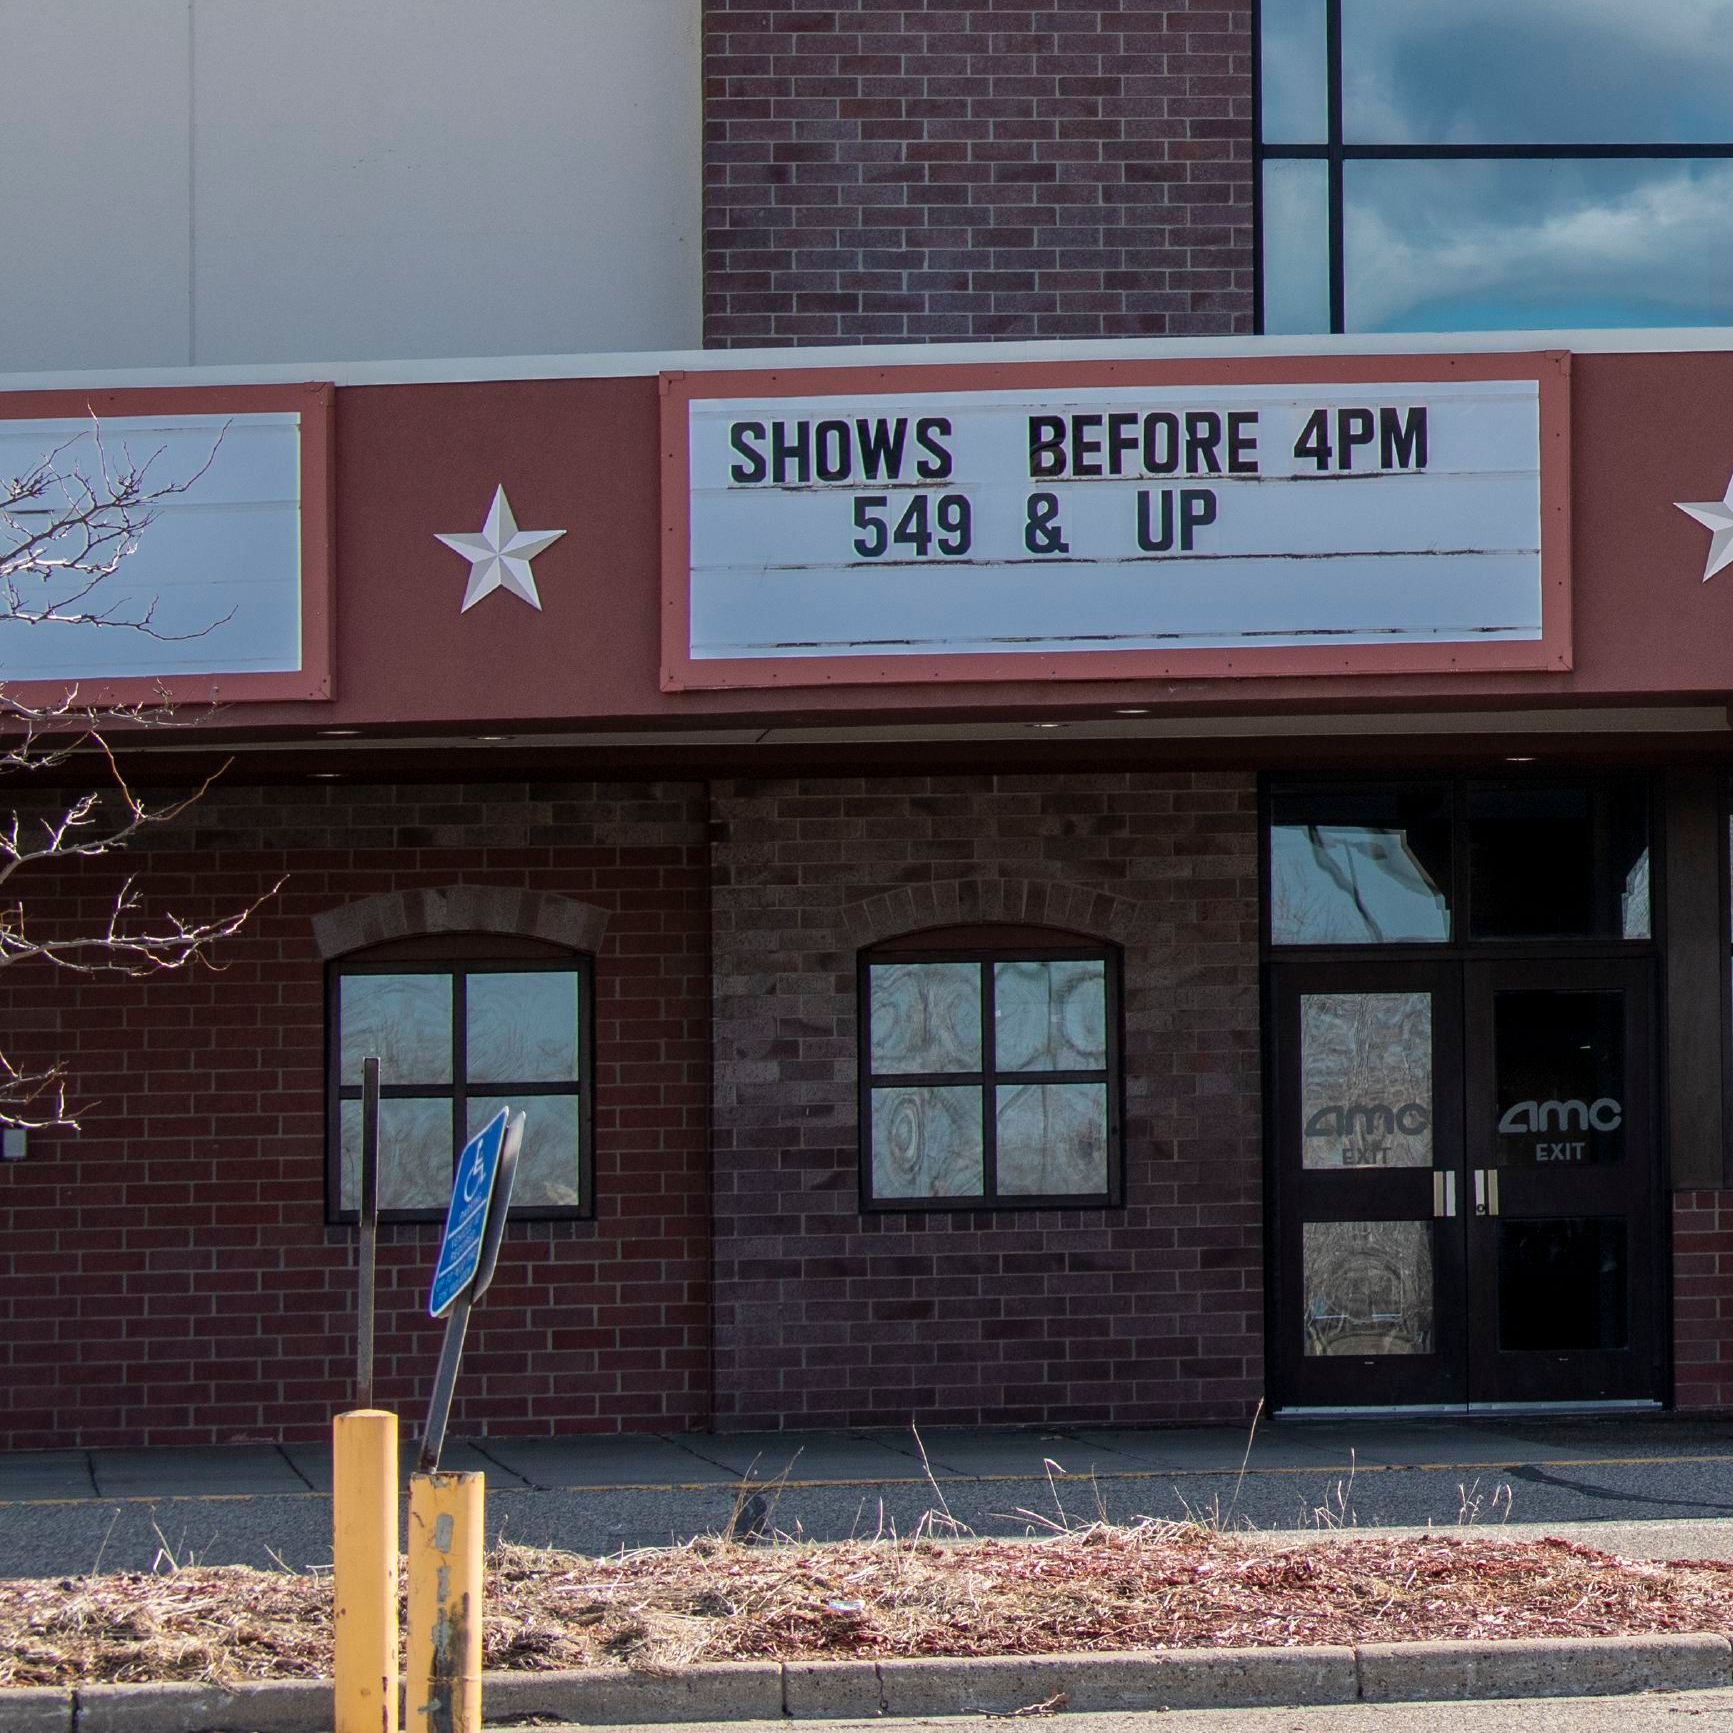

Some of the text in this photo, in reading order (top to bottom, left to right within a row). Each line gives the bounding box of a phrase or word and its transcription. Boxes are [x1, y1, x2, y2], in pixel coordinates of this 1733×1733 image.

[730, 407, 1428, 484] SHOWS BEFORE 4PM
[854, 489, 1217, 557] 549 & UP
[1342, 1147, 1391, 1165] EXIT
[1536, 1142, 1585, 1161] EXIT
